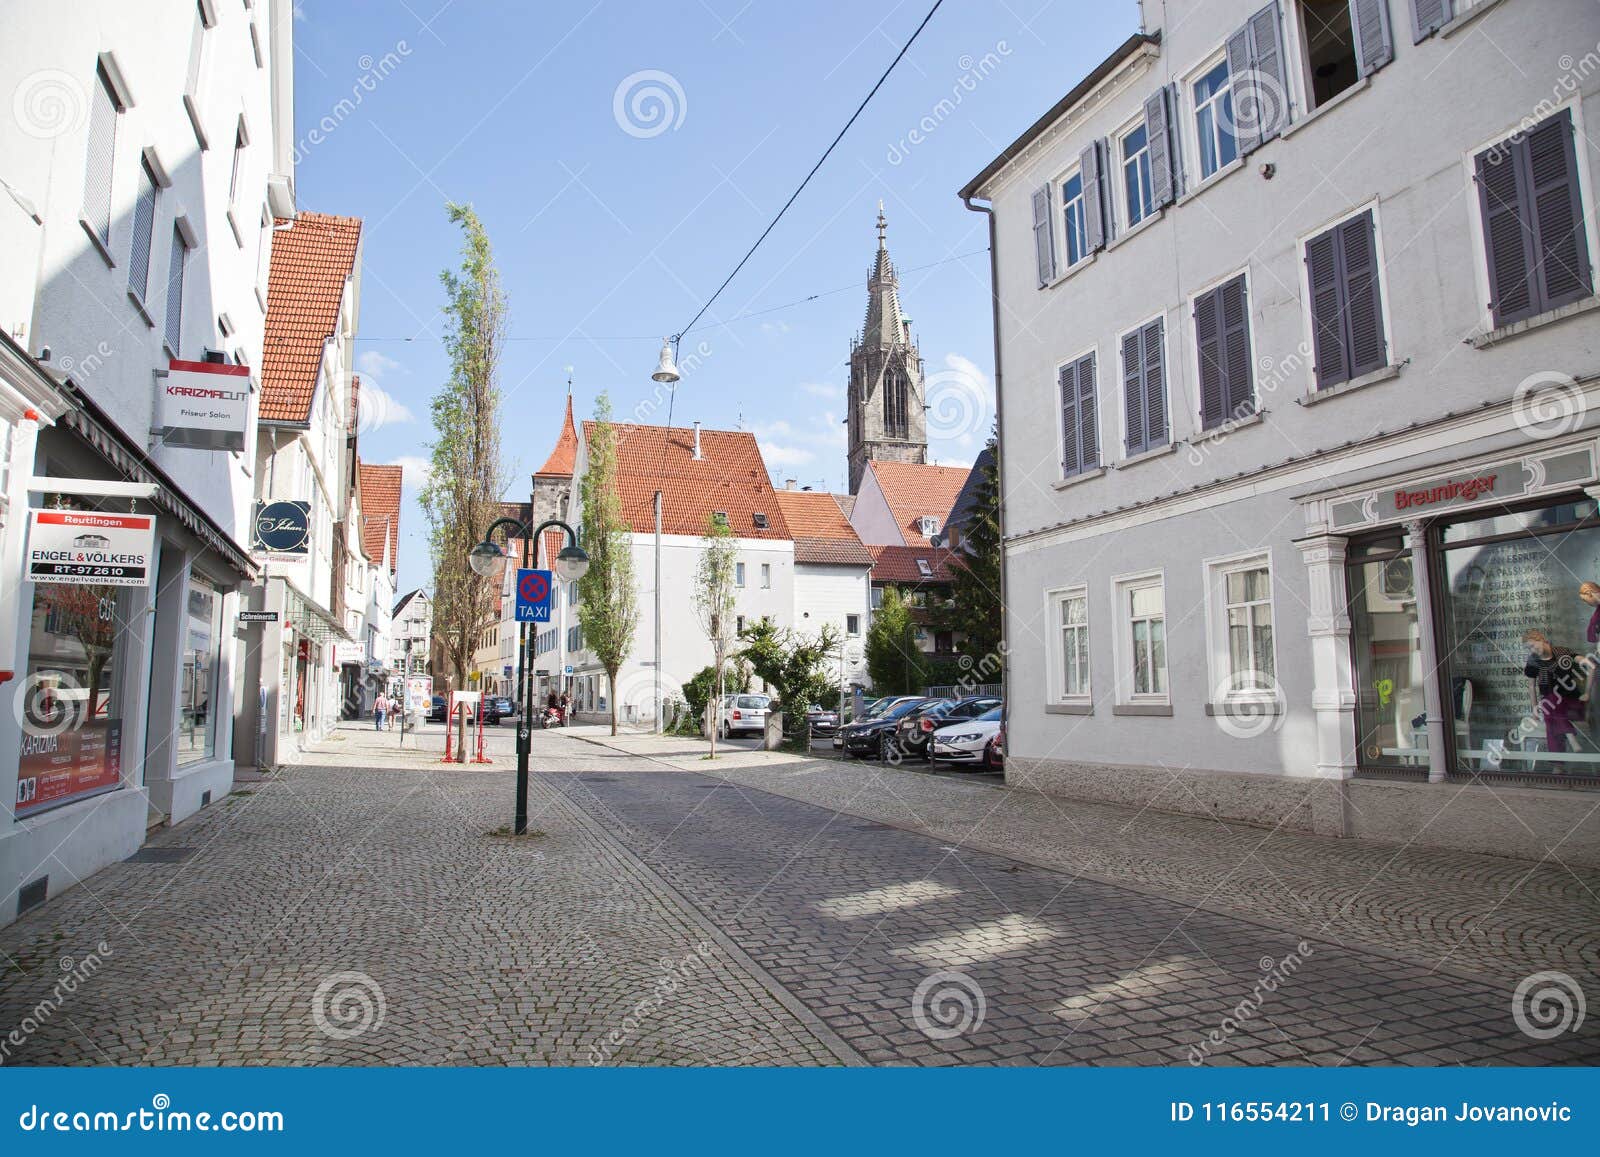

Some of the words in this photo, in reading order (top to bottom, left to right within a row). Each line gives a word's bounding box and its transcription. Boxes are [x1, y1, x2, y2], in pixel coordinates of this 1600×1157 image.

[181, 409, 207, 418] Friseur
[209, 410, 231, 419] Salon
[1394, 474, 1498, 510] Breuninger
[64, 515, 122, 527] Reutlingen
[30, 575, 145, 585] www.engelvoelkers.com
[519, 605, 547, 618] TAXI
[20, 734, 58, 756] KARIZMA
